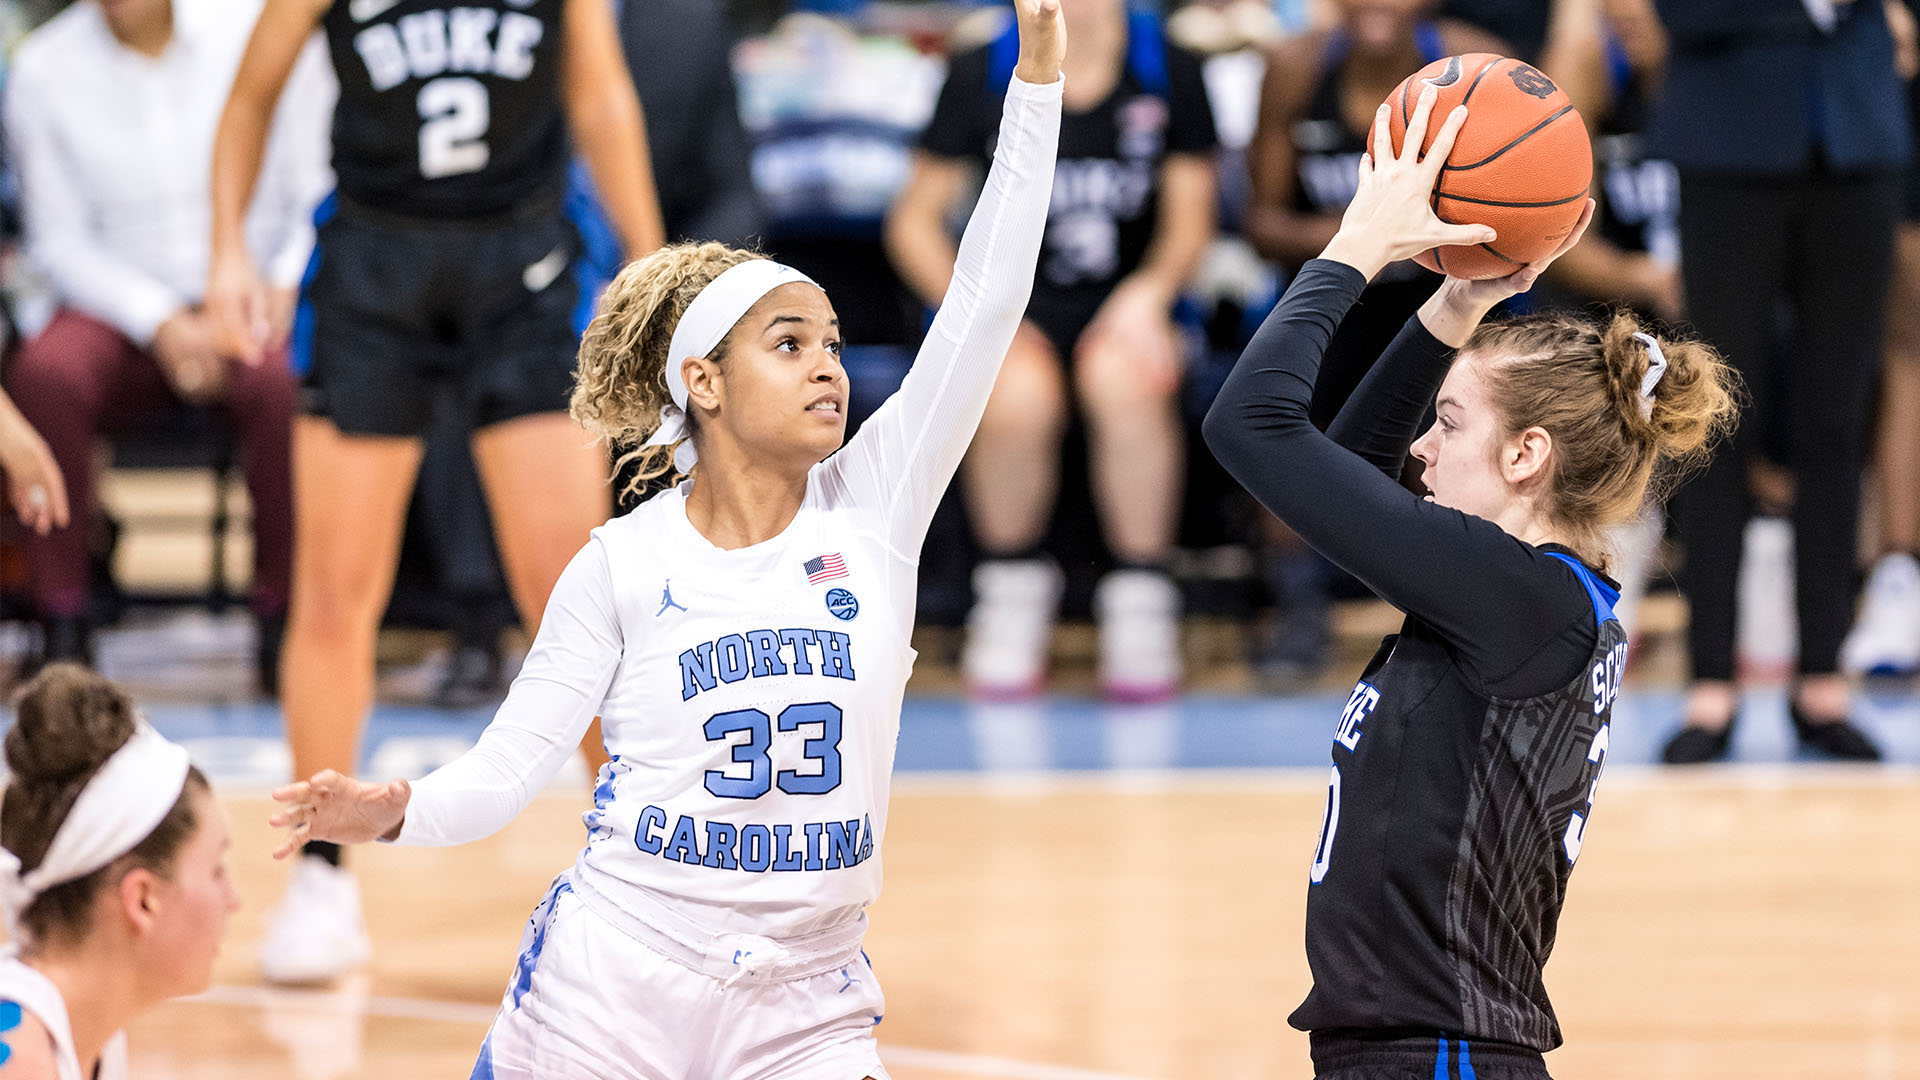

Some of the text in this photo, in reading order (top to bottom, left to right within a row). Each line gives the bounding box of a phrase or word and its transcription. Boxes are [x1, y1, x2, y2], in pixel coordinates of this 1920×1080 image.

[353, 6, 544, 93] DUKE
[416, 76, 491, 181] 2
[831, 596, 855, 607] ACC
[678, 628, 856, 702] NORTH
[703, 701, 843, 800] 33
[1333, 680, 1382, 754] KE
[1310, 761, 1342, 886] 0
[1563, 721, 1610, 868] 3
[634, 804, 874, 873] CAROLINA
